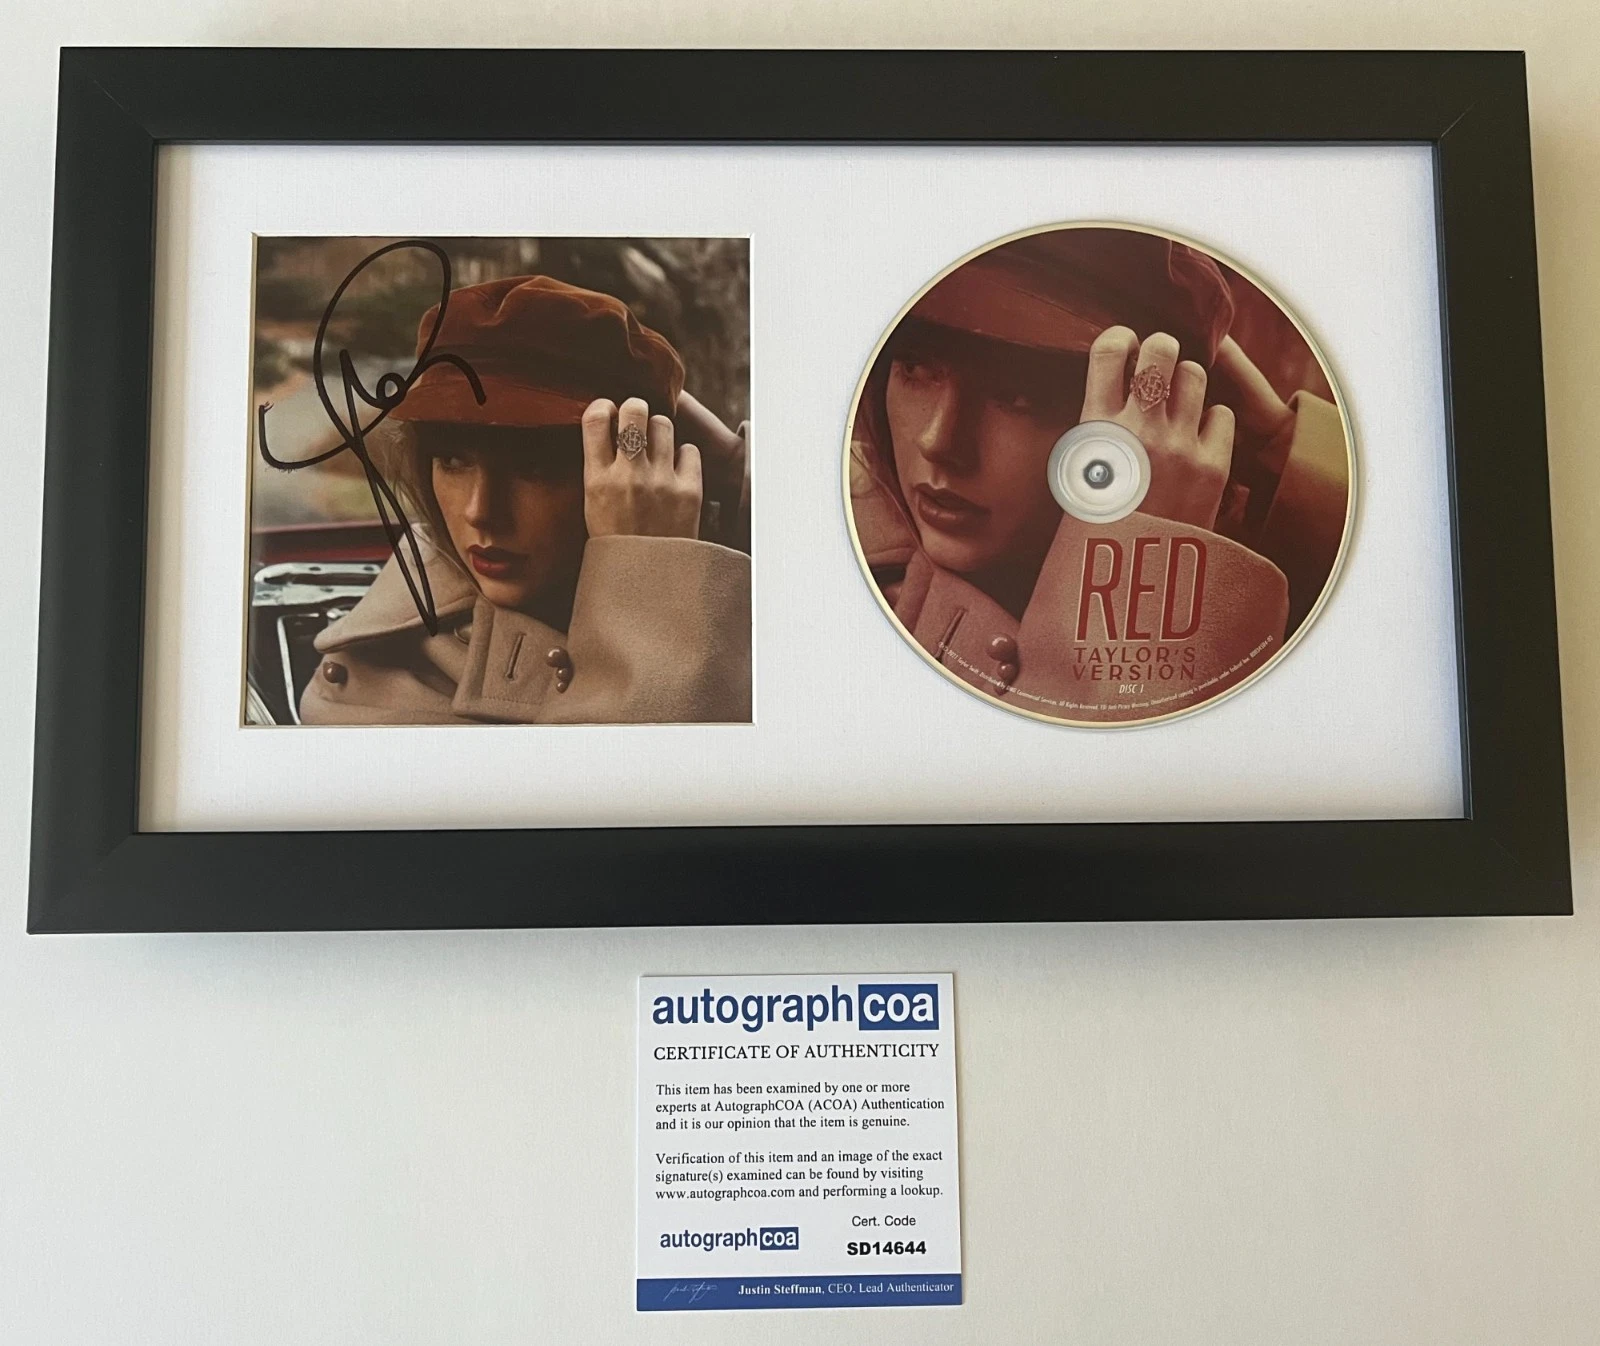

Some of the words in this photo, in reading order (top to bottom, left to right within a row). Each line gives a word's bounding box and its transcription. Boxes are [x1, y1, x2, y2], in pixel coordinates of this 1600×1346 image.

[1075, 537, 1207, 642] RED
[1074, 647, 1196, 663] TAYLOR'S
[1073, 664, 1196, 680] VERSION
[1119, 684, 1137, 693] DISC
[1139, 684, 1144, 693] 1
[654, 1046, 770, 1060] CERTIFICATE
[776, 1045, 799, 1058] OF
[805, 1044, 939, 1058] AUTHENTICITY
[656, 1084, 681, 1095] This
[685, 1084, 708, 1094] item
[714, 1084, 732, 1094] has
[737, 1083, 762, 1094] been
[767, 1082, 820, 1093] examined
[825, 1082, 838, 1095] by
[882, 1084, 910, 1092] more
[656, 1103, 696, 1115] experts
[701, 1103, 710, 1111] at
[715, 1100, 804, 1114] AutographCOA
[809, 1099, 857, 1112] (ACOA)
[861, 1098, 944, 1109] Authentication
[656, 1119, 675, 1129] and
[681, 1119, 687, 1129] it
[692, 1118, 701, 1129] is
[705, 1121, 723, 1129] our
[727, 1117, 770, 1131] opinion
[775, 1117, 795, 1128] that
[800, 1117, 816, 1127] the
[821, 1117, 845, 1127] item
[850, 1116, 858, 1126] is
[862, 1116, 909, 1129] genuine.
[656, 1153, 724, 1164] Verification
[729, 1152, 742, 1163] of
[745, 1152, 764, 1163] this
[769, 1152, 793, 1162] item
[797, 1151, 817, 1162] and
[839, 1151, 872, 1164] image
[877, 1150, 889, 1161] of
[892, 1150, 909, 1160] the
[913, 1151, 942, 1160] exact
[656, 1170, 723, 1184] signature(s)
[727, 1169, 782, 1180] examined
[809, 1168, 822, 1179] be
[827, 1168, 859, 1179] found
[863, 1168, 877, 1181] by
[881, 1167, 923, 1181] visiting
[656, 1187, 794, 1201] www.autographcoa.com
[799, 1186, 819, 1197] and
[823, 1185, 886, 1199] performing
[901, 1185, 942, 1198] lookup.
[852, 1216, 880, 1226] Cert.
[885, 1215, 916, 1226] Code
[847, 1241, 926, 1255] SD14644
[739, 1285, 770, 1294] Justin
[774, 1284, 824, 1294] Steffman,
[828, 1284, 855, 1293] CEO,
[860, 1283, 883, 1292] Lead
[887, 1282, 954, 1292] Authenticator
